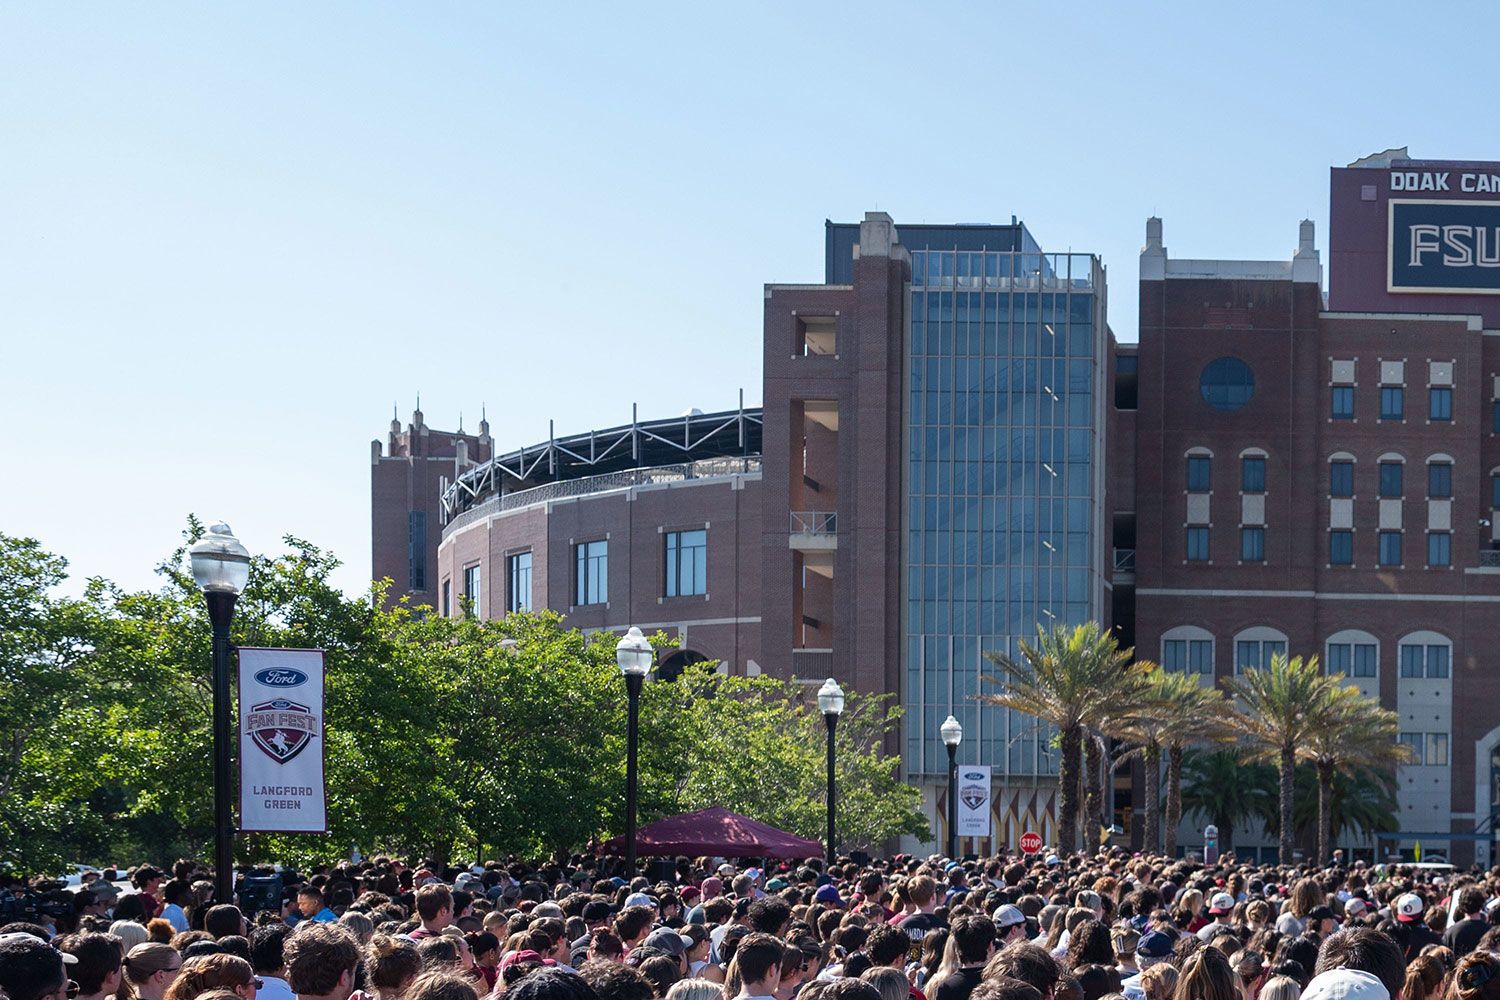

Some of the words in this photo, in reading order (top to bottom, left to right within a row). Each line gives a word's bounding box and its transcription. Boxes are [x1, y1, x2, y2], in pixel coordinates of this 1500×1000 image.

[1390, 172, 1450, 191] DOAK
[265, 669, 297, 685] Ford
[247, 713, 275, 731] FAN
[278, 712, 317, 731] FEST
[253, 785, 313, 796] LANGFORD
[264, 800, 301, 810] GREEN
[1021, 838, 1041, 848] STOP
